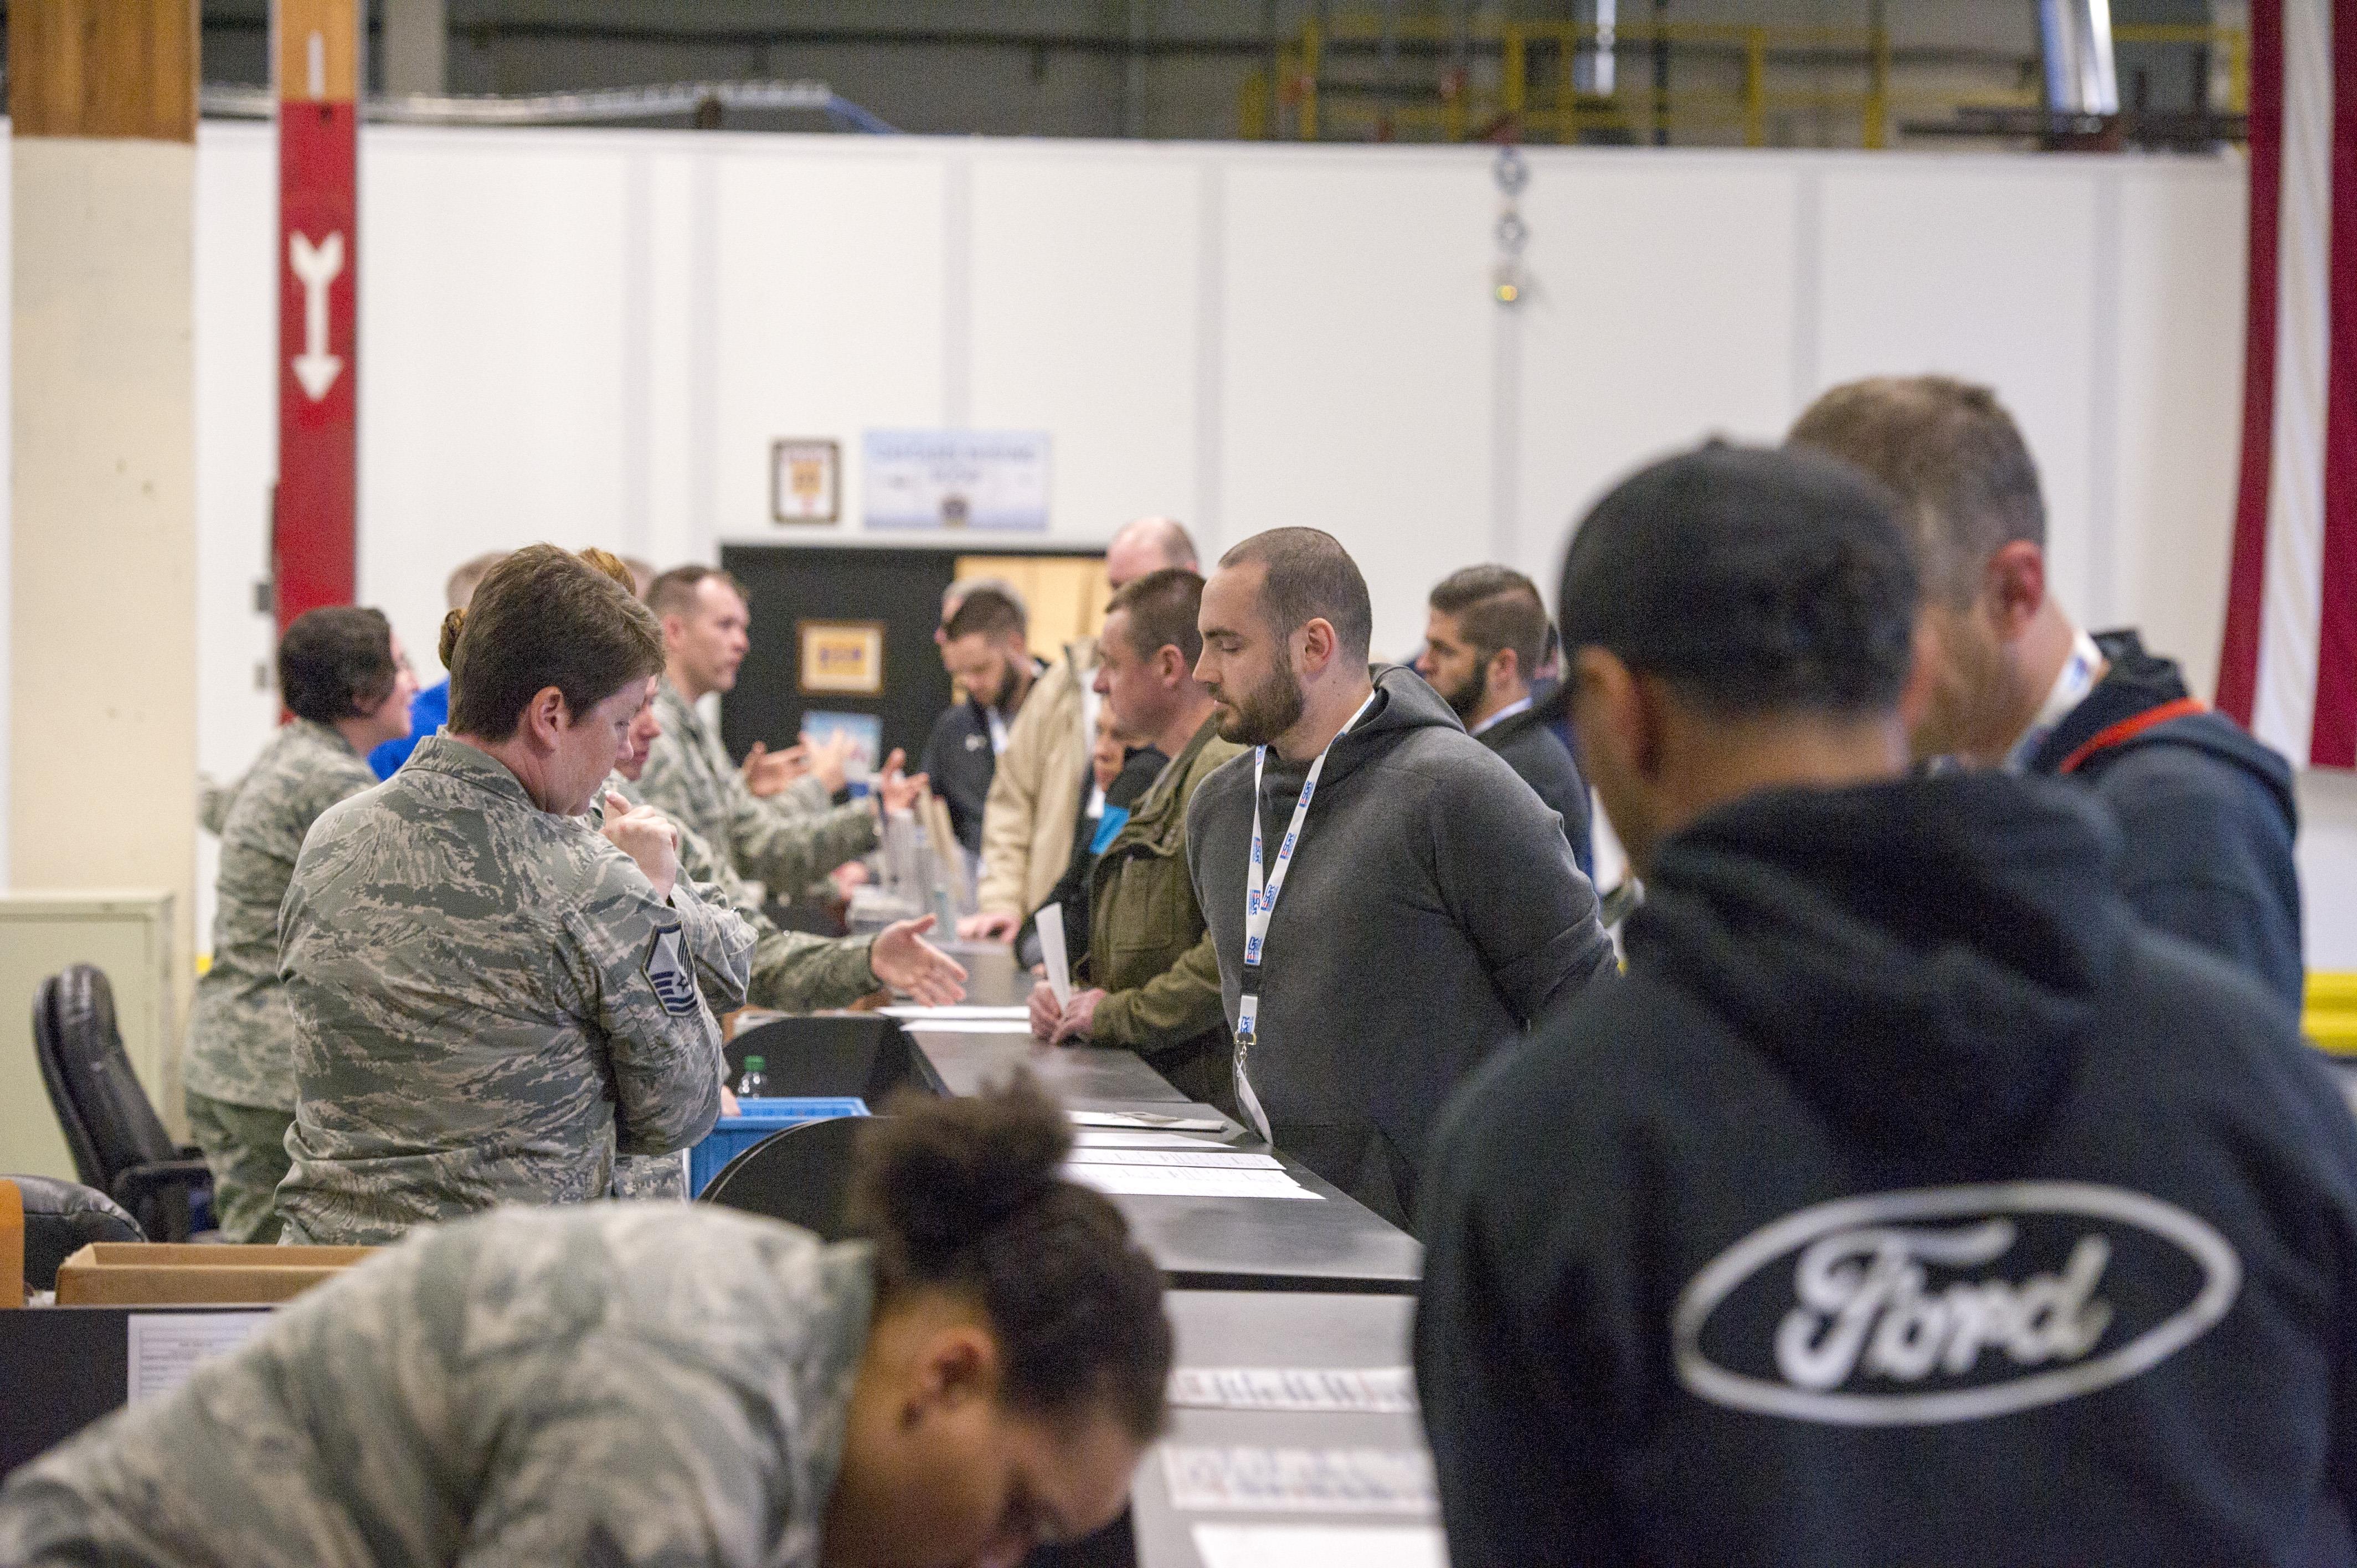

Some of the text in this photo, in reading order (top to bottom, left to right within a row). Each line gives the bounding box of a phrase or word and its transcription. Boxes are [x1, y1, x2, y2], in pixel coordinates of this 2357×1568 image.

[1299, 780, 1312, 807] ESGR
[1280, 833, 1294, 859] ESGR
[1260, 884, 1275, 911] ESGR
[1778, 1220, 2111, 1391] Ford
